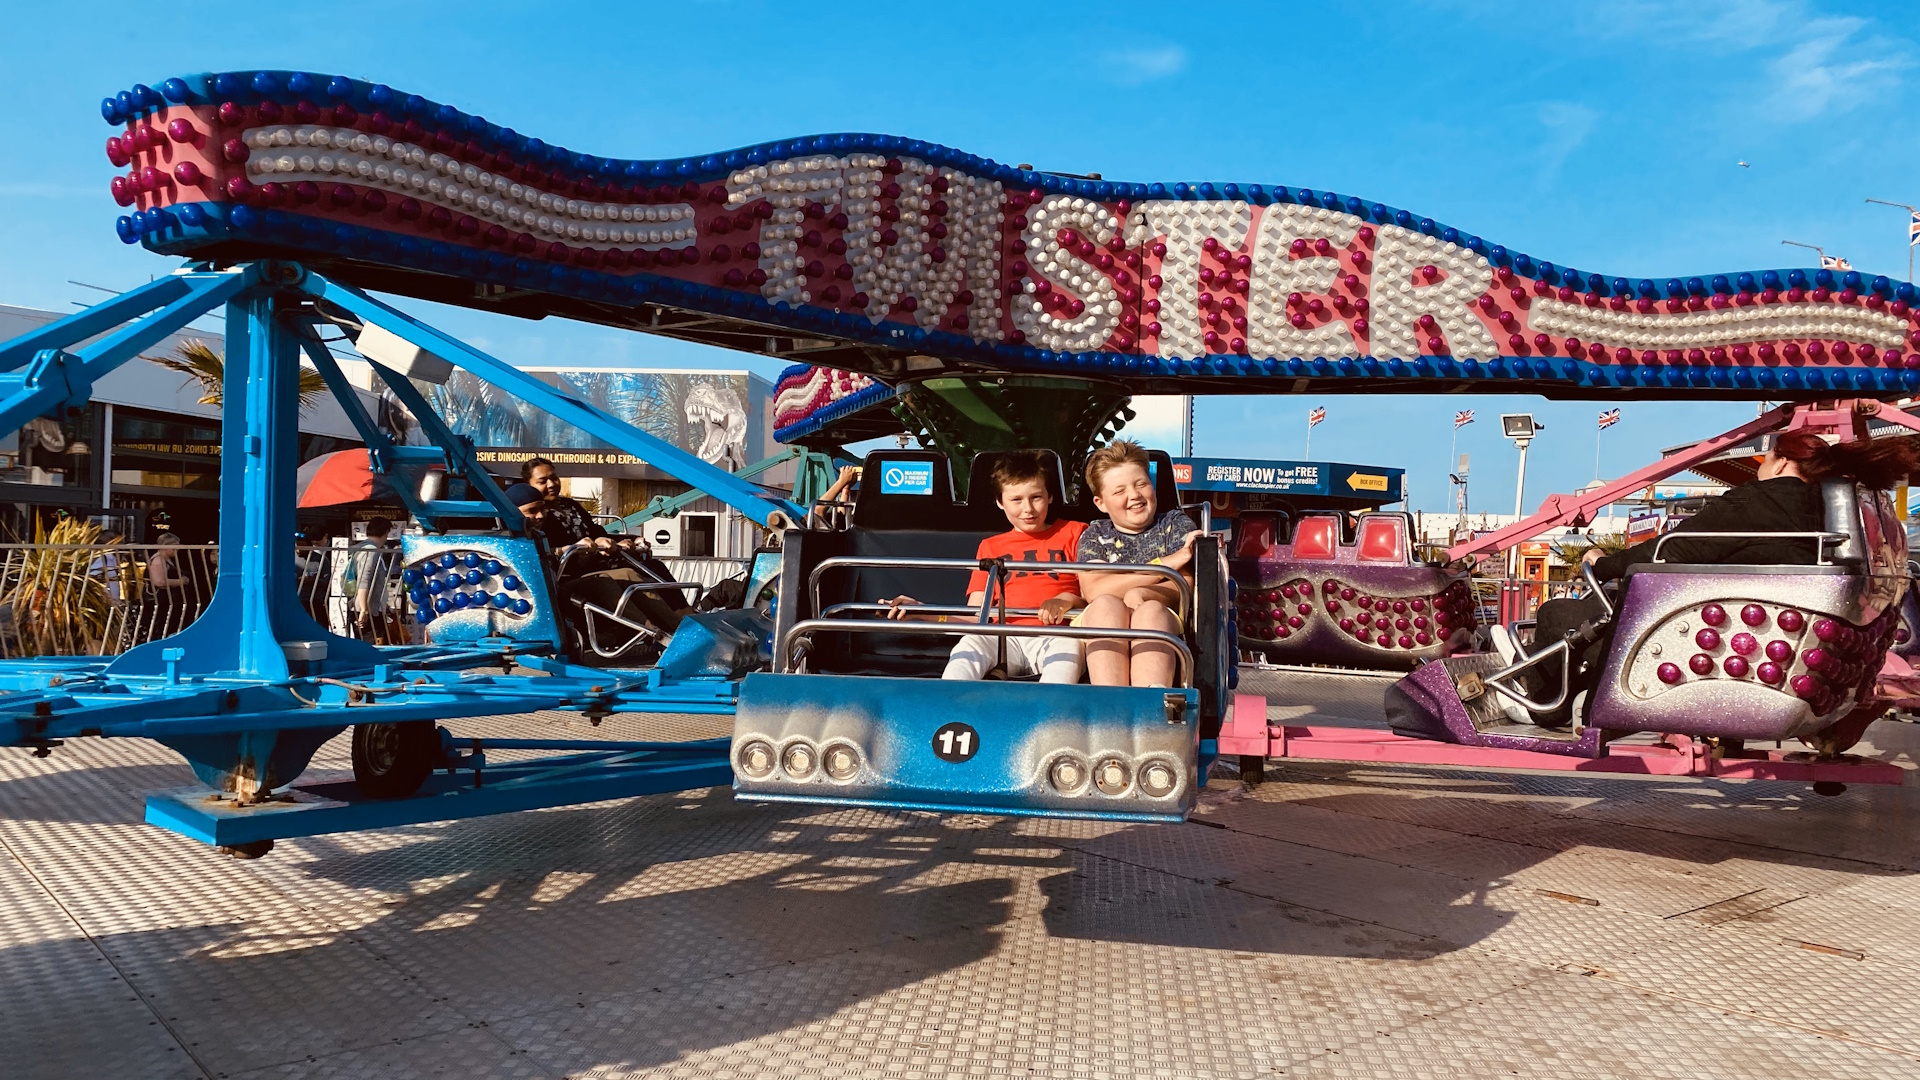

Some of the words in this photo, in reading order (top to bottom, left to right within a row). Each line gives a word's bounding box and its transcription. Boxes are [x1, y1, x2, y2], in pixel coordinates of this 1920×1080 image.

[726, 152, 1500, 362] TWISTER
[476, 451, 496, 462] SIVE
[498, 452, 536, 463] DINOSAUR
[538, 453, 596, 464] WALKTHROUGH
[598, 454, 604, 464] &
[605, 454, 616, 464] 4D
[1206, 473, 1223, 481] EACH
[1224, 474, 1241, 482] CARD
[1207, 465, 1242, 475] REGISTER
[1243, 467, 1276, 483] NOW
[1277, 468, 1284, 476] To
[1295, 466, 1319, 478] FREE
[1277, 476, 1294, 484] bonus
[1295, 477, 1319, 485] credits!
[938, 729, 972, 756] 11
